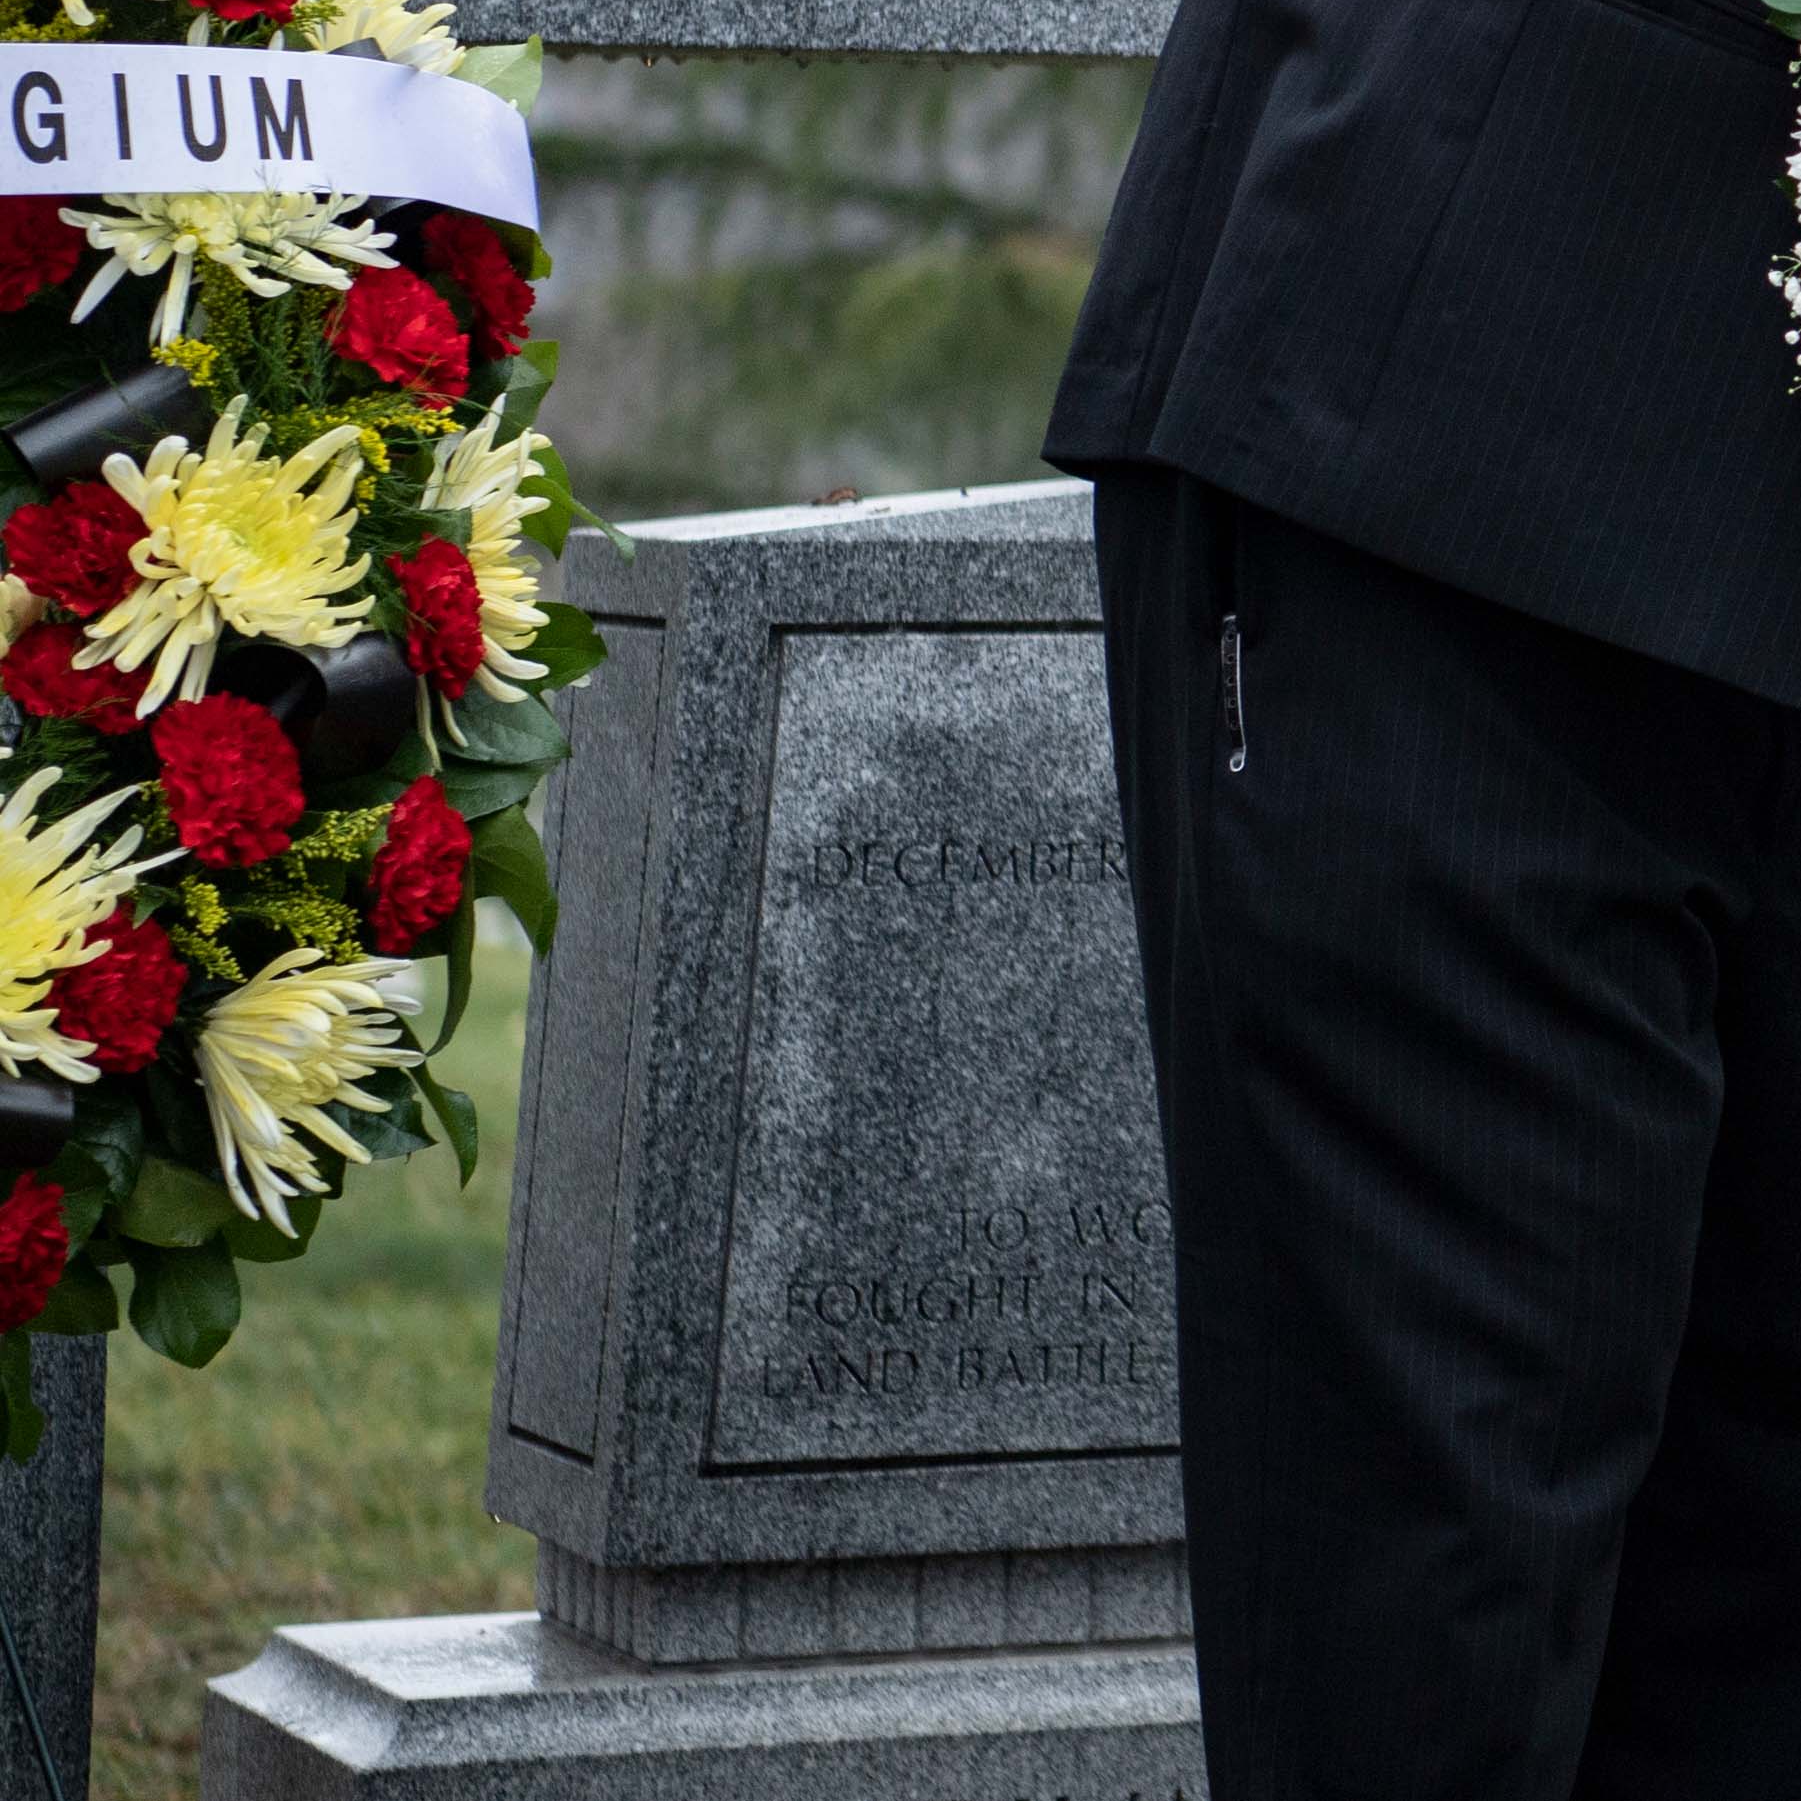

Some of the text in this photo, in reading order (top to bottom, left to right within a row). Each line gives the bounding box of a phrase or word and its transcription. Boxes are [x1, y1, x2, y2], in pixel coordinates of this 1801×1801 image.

[12, 70, 314, 165] GIUM
[811, 839, 1128, 888] DECEMBER
[952, 1205, 1029, 1253] TO
[785, 1274, 1044, 1327] FOUGHT
[1081, 1271, 1141, 1318] IN
[762, 1350, 920, 1399] LAND
[957, 1341, 1155, 1391] BATTLE
